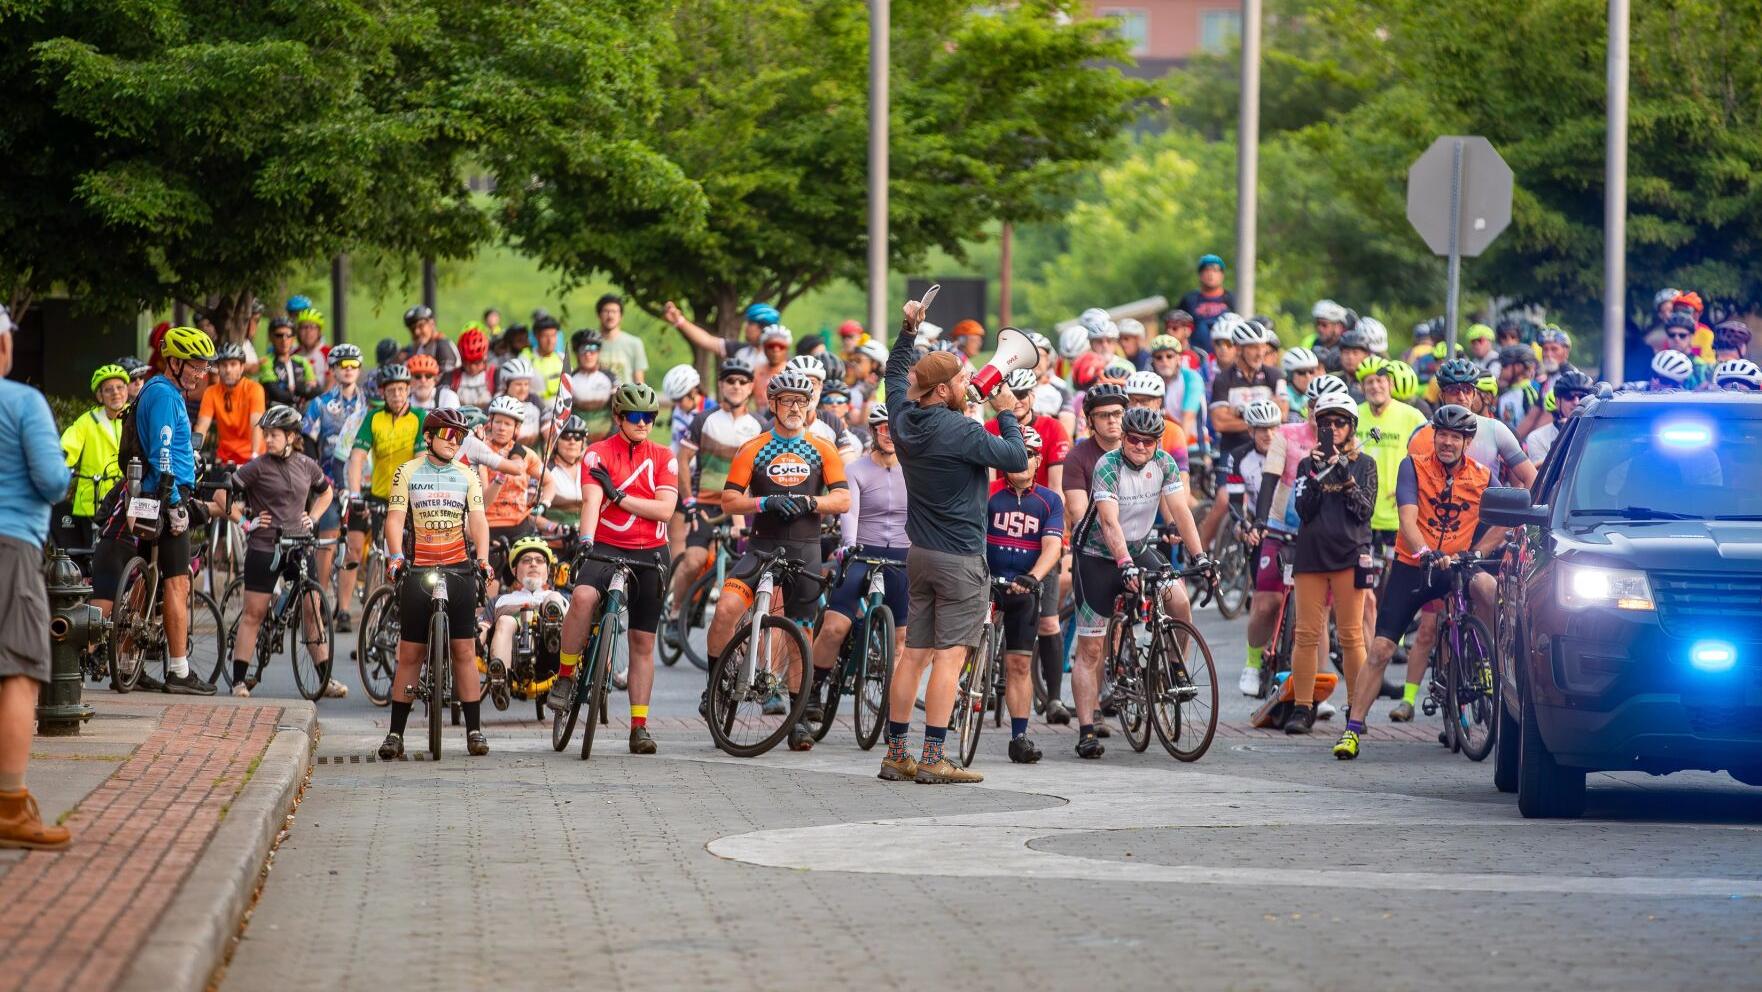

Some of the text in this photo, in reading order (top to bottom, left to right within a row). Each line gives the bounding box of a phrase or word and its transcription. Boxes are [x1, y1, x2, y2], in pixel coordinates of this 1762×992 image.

[769, 465, 809, 475] Cycle
[413, 499, 441, 509] WINTER
[419, 510, 439, 519] TRACK
[993, 511, 1039, 538] USA
